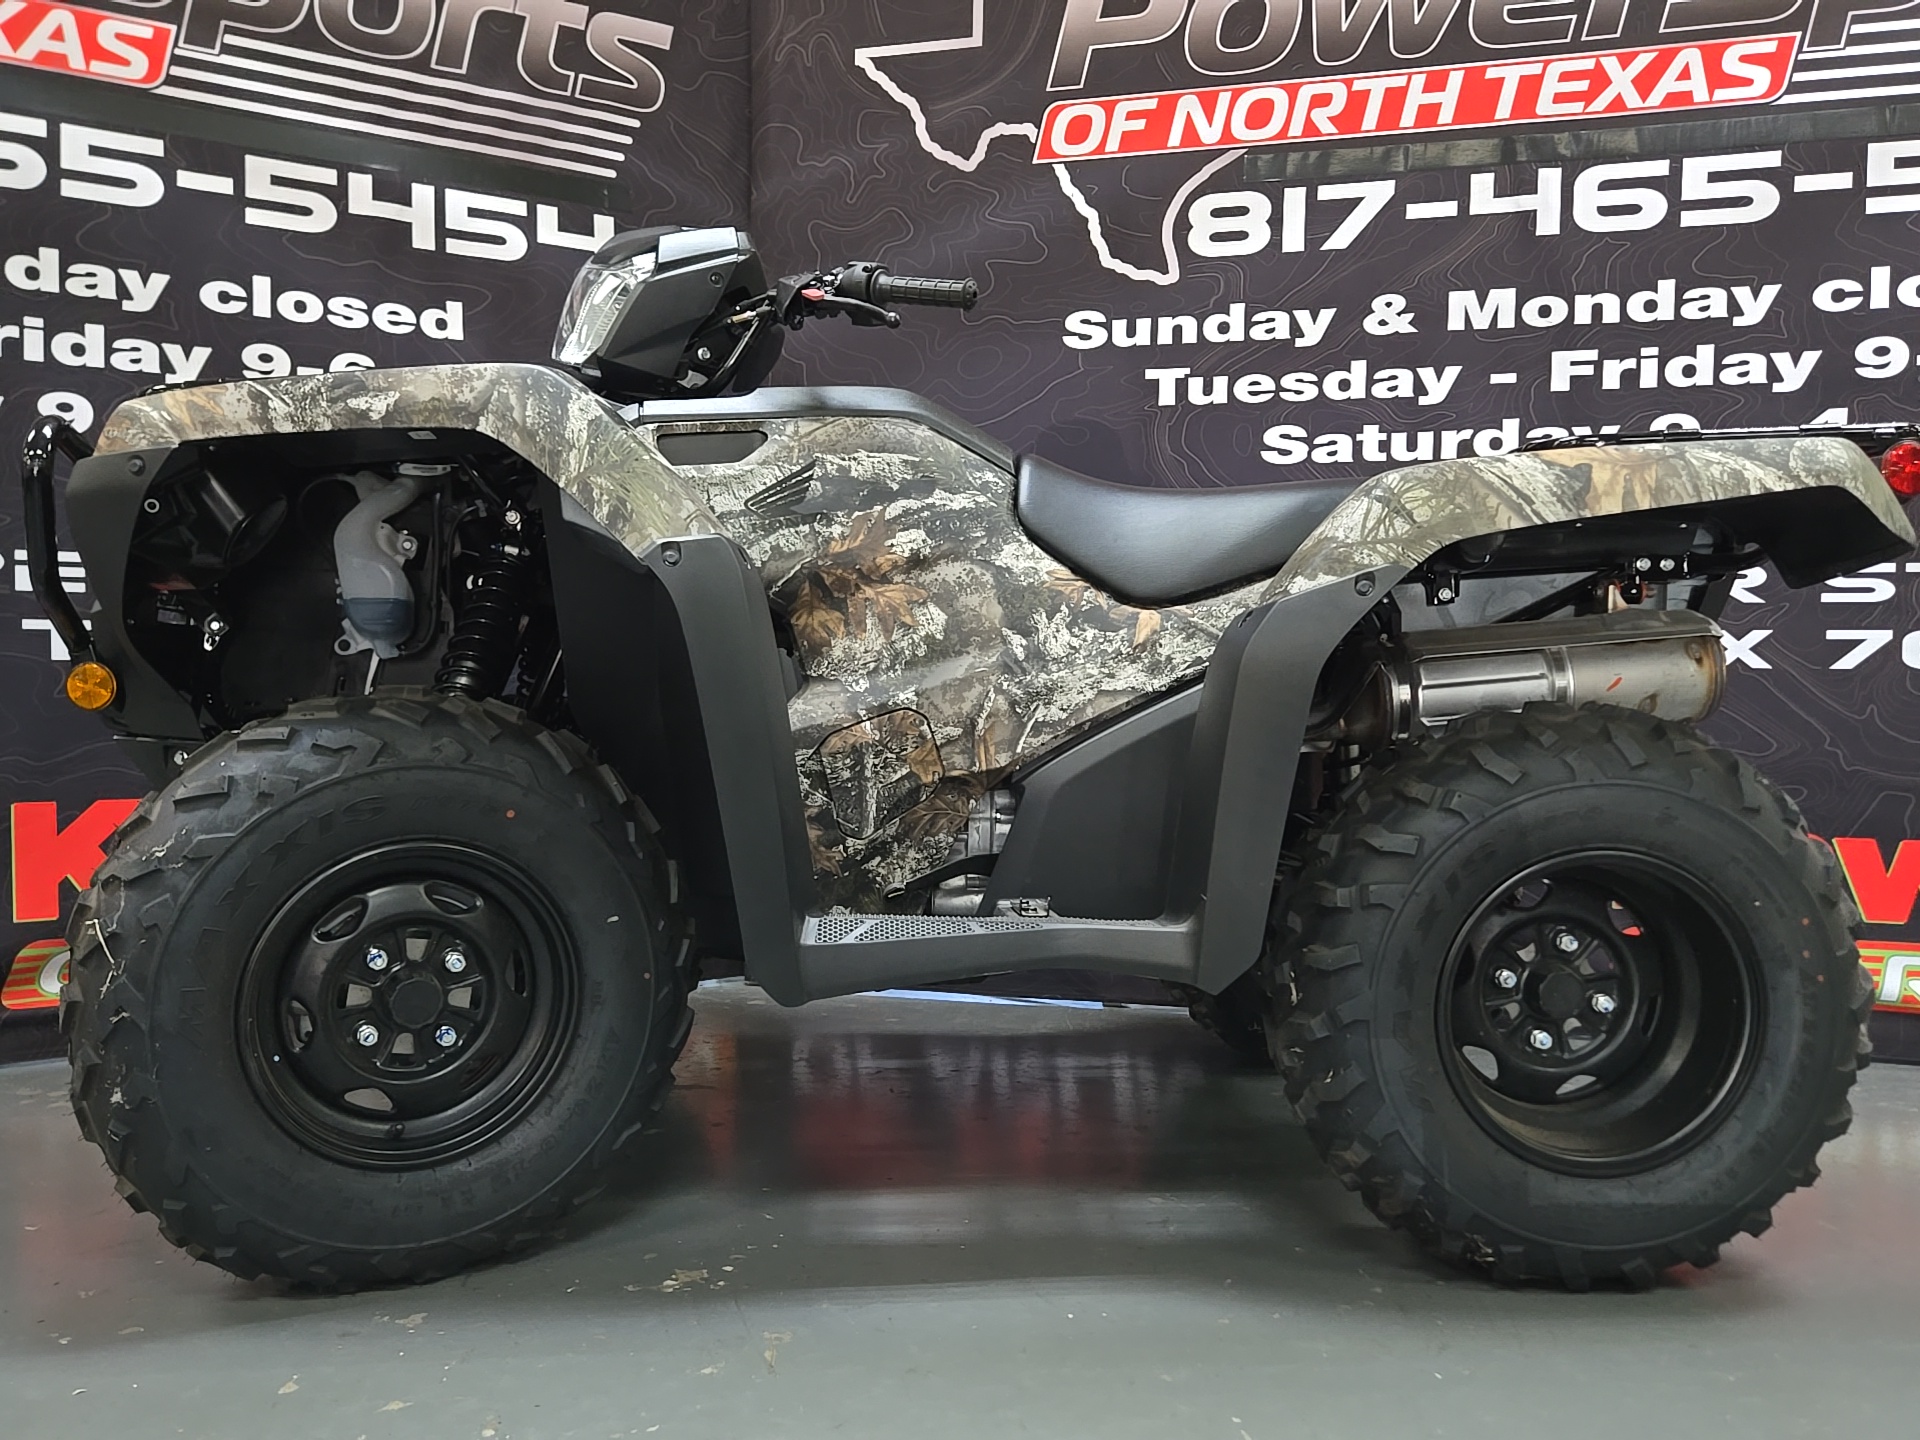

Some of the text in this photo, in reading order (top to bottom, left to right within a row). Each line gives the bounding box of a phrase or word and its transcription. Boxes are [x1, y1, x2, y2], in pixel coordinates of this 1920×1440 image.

[105, 0, 676, 112] orts
[1050, 40, 1778, 156] OF NORTH TEXAS
[199, 275, 464, 340] closed
[1062, 302, 1338, 350] Sunday
[1362, 293, 1419, 336] &
[1447, 279, 1782, 331] Monday
[1144, 359, 1463, 406] Tuesday
[1550, 343, 1822, 393] Friday
[1260, 418, 1621, 465] Saturd
